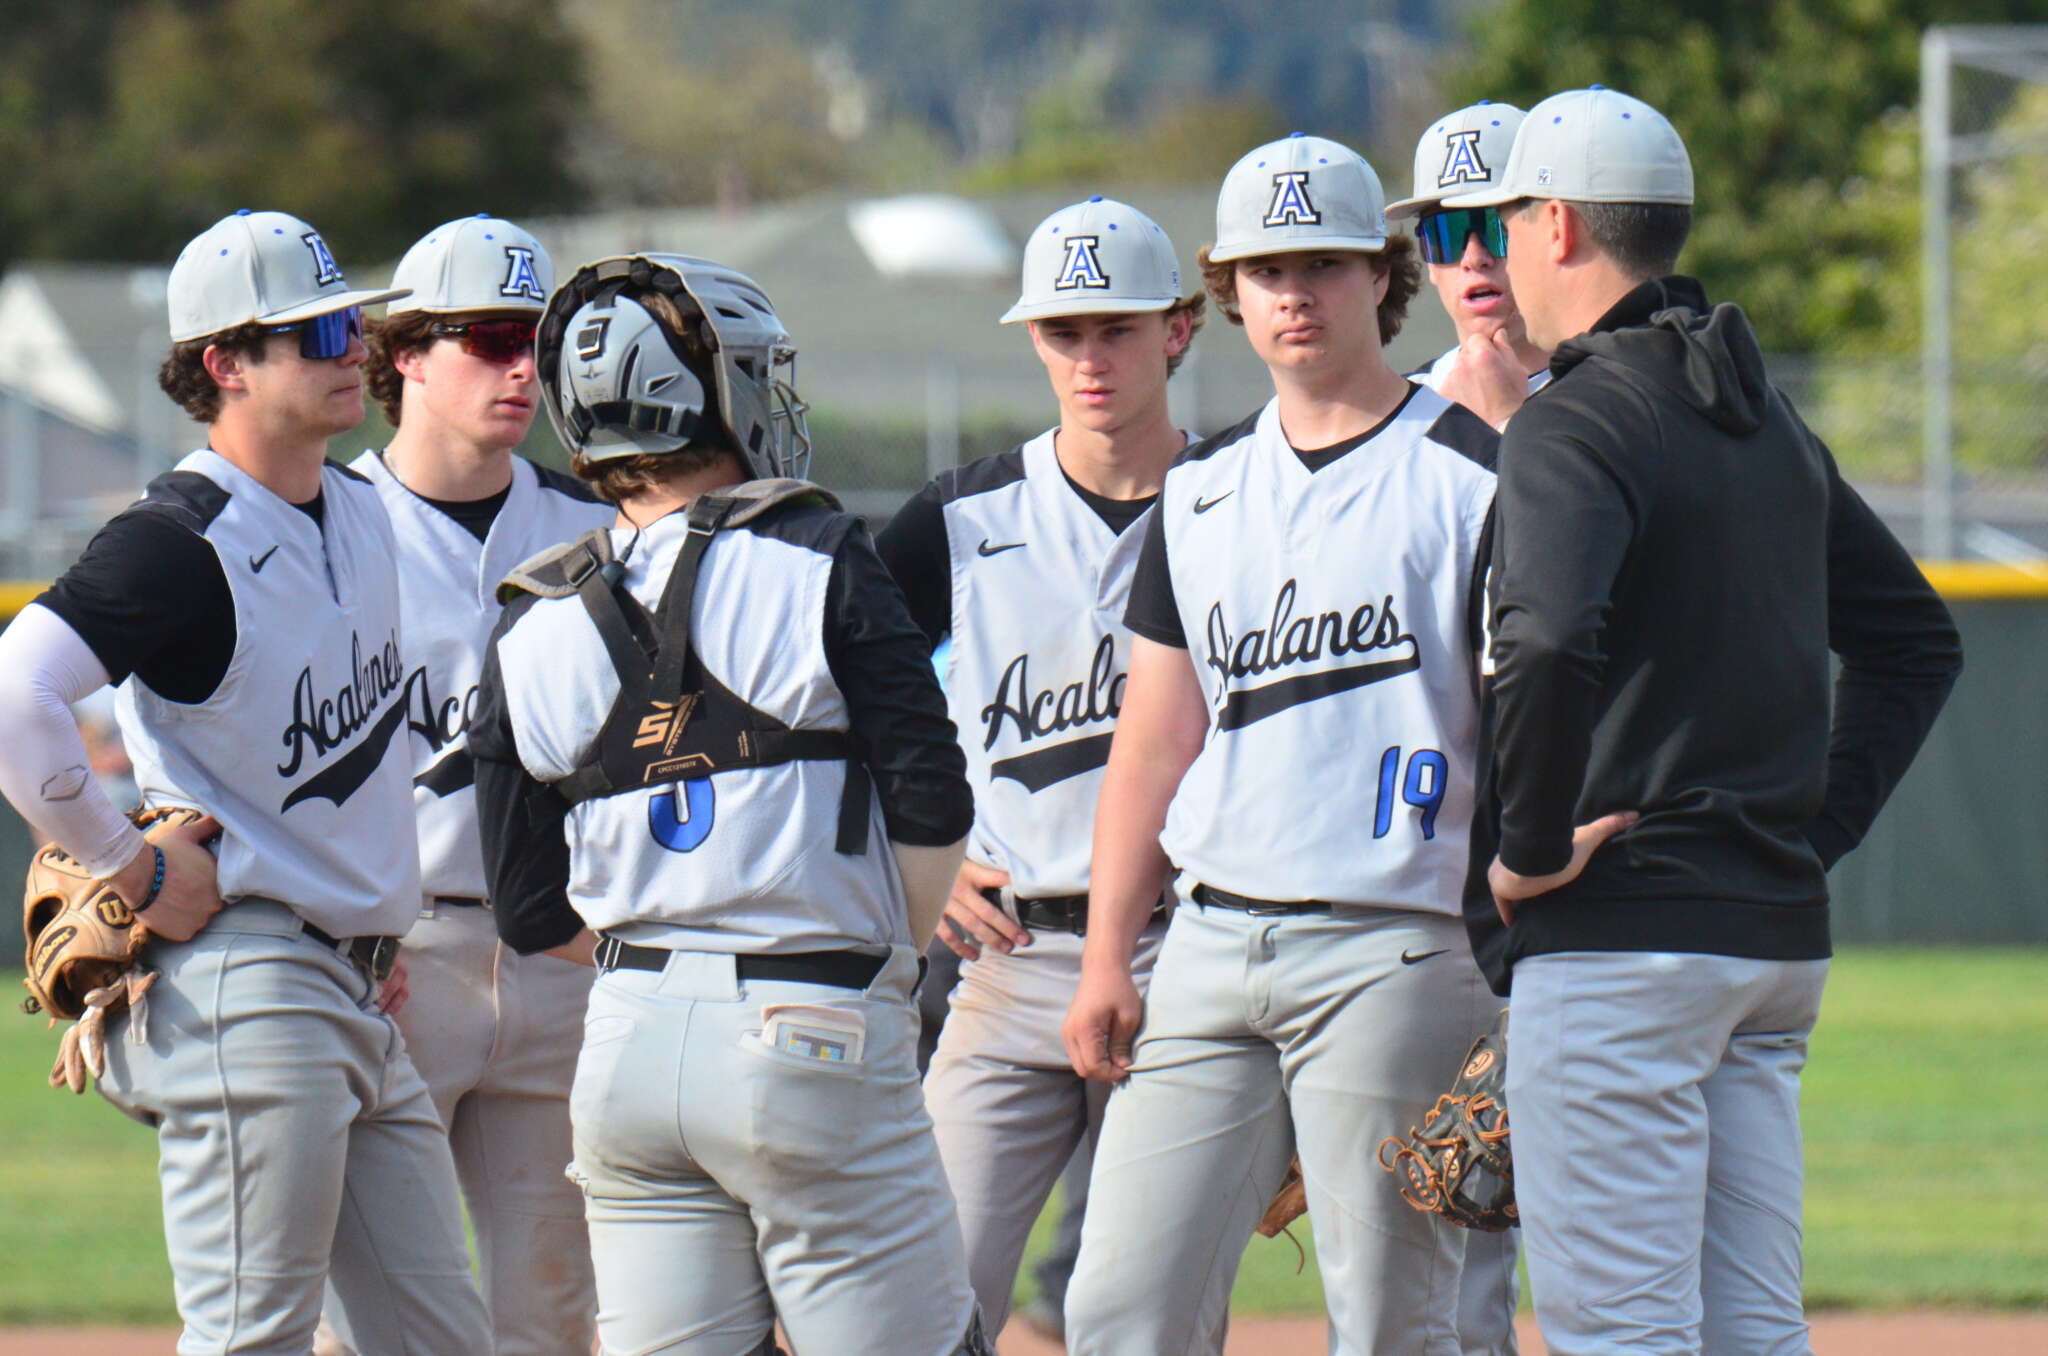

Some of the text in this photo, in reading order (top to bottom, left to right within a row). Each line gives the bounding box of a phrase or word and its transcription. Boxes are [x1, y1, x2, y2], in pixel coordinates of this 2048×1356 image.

[1438, 130, 1491, 188] A
[1263, 171, 1321, 228] A
[301, 232, 344, 287] A
[500, 246, 545, 302] A
[1055, 235, 1110, 291] A
[1373, 746, 1448, 840] 19
